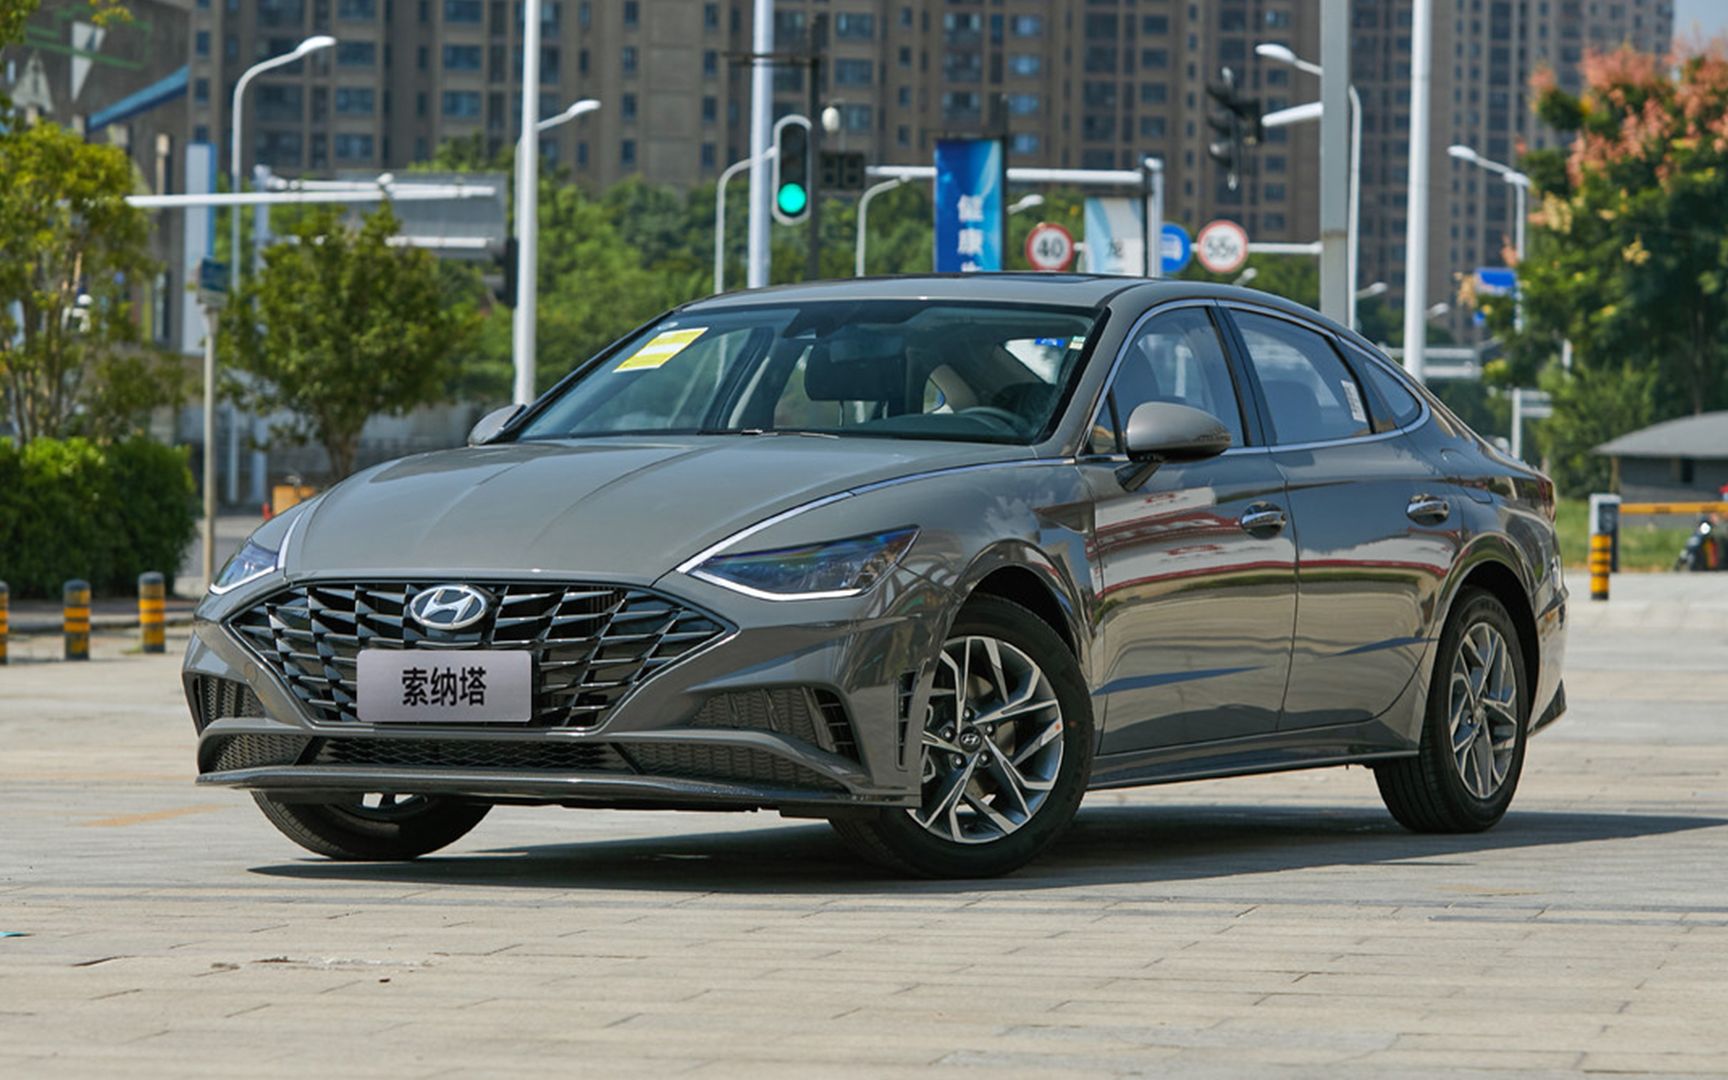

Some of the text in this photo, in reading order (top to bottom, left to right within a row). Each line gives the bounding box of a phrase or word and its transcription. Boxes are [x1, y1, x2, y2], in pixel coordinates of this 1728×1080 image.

[1037, 237, 1065, 258] 40
[402, 666, 487, 707] 索纳塔
